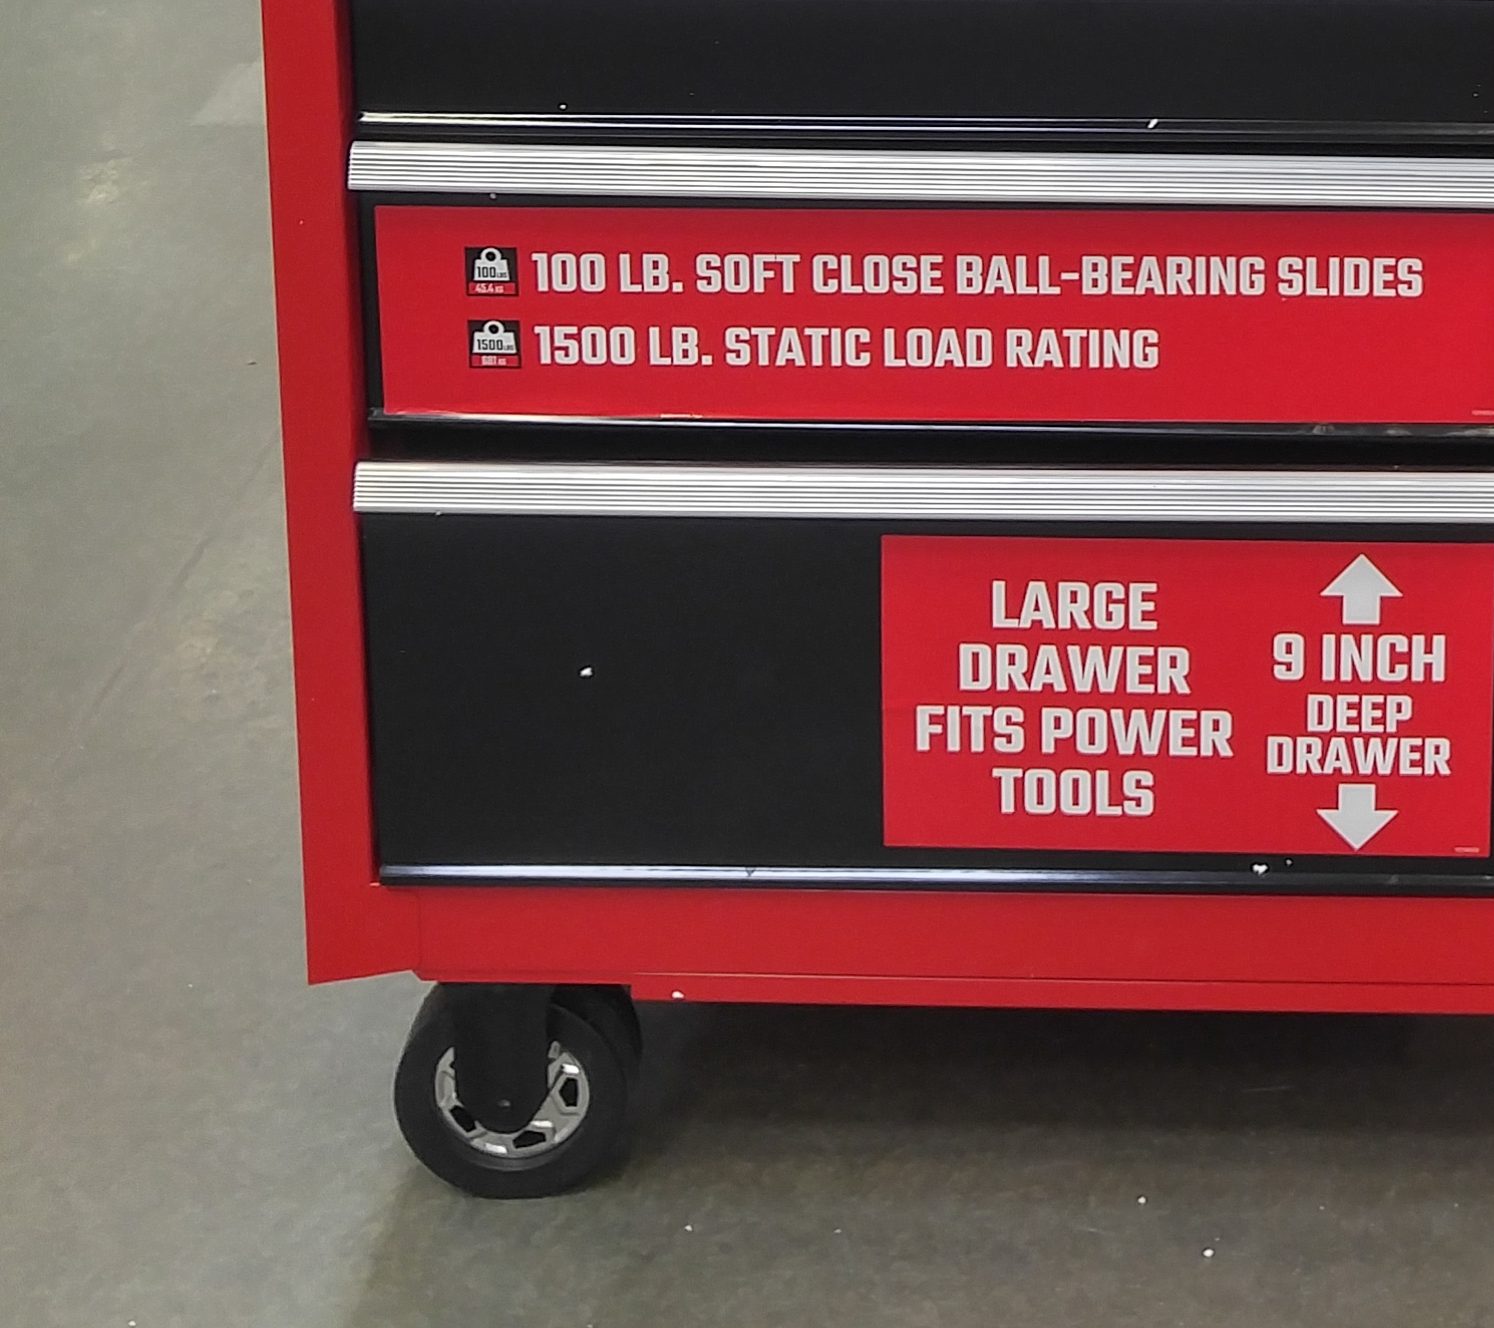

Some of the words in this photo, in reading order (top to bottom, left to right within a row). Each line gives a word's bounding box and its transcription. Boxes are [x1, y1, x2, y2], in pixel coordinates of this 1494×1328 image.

[477, 266, 497, 279] 100
[531, 252, 606, 293] 100
[619, 252, 684, 294] LB.
[696, 253, 801, 294] SOFT
[812, 254, 944, 295] CLOSE
[955, 255, 1266, 297] BALL-BEARING
[1277, 256, 1424, 298] SLIDES
[477, 338, 503, 351] 1500
[533, 325, 636, 366] 1500
[648, 326, 713, 367] LB.
[725, 327, 871, 368] STATIC
[883, 327, 993, 369] LOAD
[1005, 328, 1160, 370] RATING
[991, 579, 1158, 631] LARGE
[959, 642, 1191, 694] DRAWER
[1272, 632, 1306, 681] 9
[1321, 634, 1446, 683] INCH
[915, 705, 1025, 755] FITS
[1041, 707, 1234, 758] POWER
[1306, 693, 1413, 733] DEEP
[1267, 736, 1452, 776] DRAWER
[992, 767, 1155, 817] TOOLS
